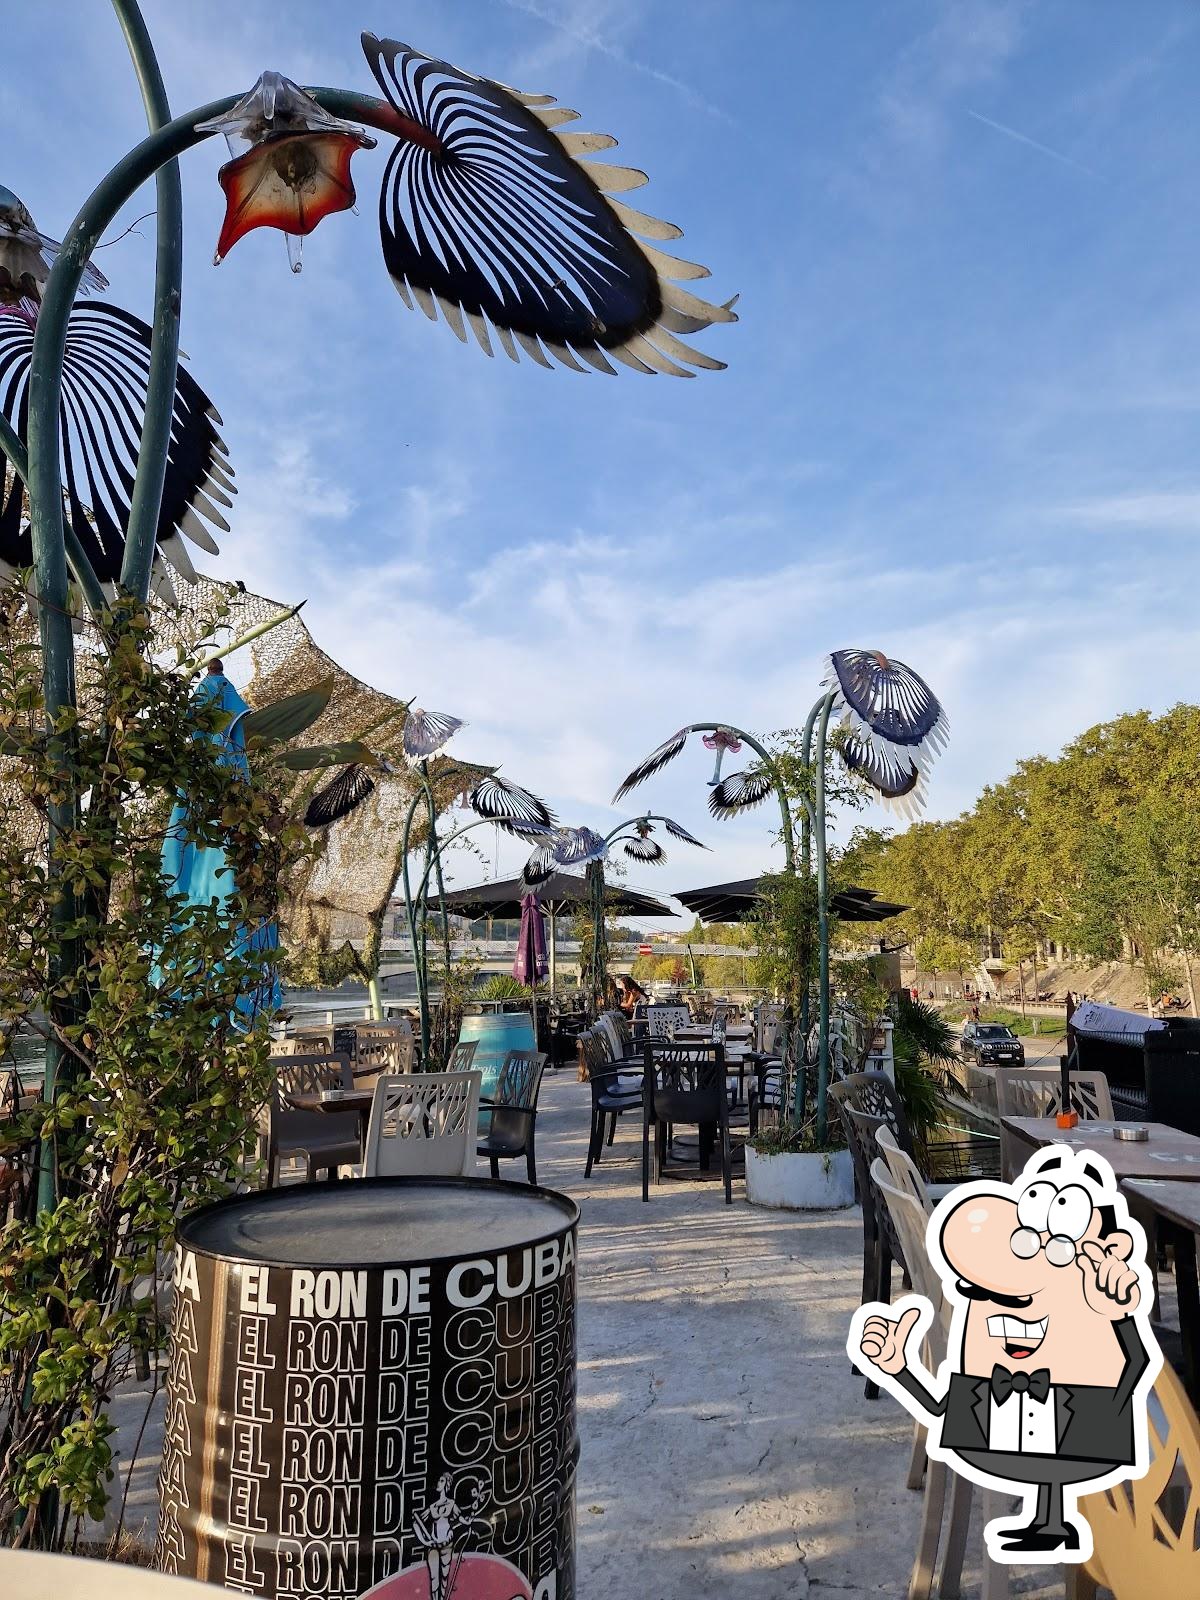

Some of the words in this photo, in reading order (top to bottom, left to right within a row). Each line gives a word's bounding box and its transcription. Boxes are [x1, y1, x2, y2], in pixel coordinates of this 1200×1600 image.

[239, 1264, 277, 1316] EL
[290, 1269, 368, 1319] RON
[381, 1266, 431, 1316] DE
[445, 1231, 575, 1308] CUBA
[237, 1314, 276, 1369] EL
[286, 1320, 368, 1373] RON
[379, 1316, 431, 1370] DE
[444, 1272, 575, 1360] CUBA
[234, 1366, 273, 1423] EL
[284, 1372, 366, 1427] RON
[376, 1368, 431, 1426] DE
[442, 1320, 575, 1413] CUBA
[230, 1419, 270, 1479] EL
[282, 1428, 364, 1482] RON
[374, 1424, 430, 1481] DE
[440, 1366, 575, 1468] CUBA
[228, 1473, 268, 1533] EL
[279, 1483, 361, 1538] RON
[371, 1479, 430, 1537] DE
[224, 1528, 265, 1588] EL
[276, 1539, 360, 1593] RON
